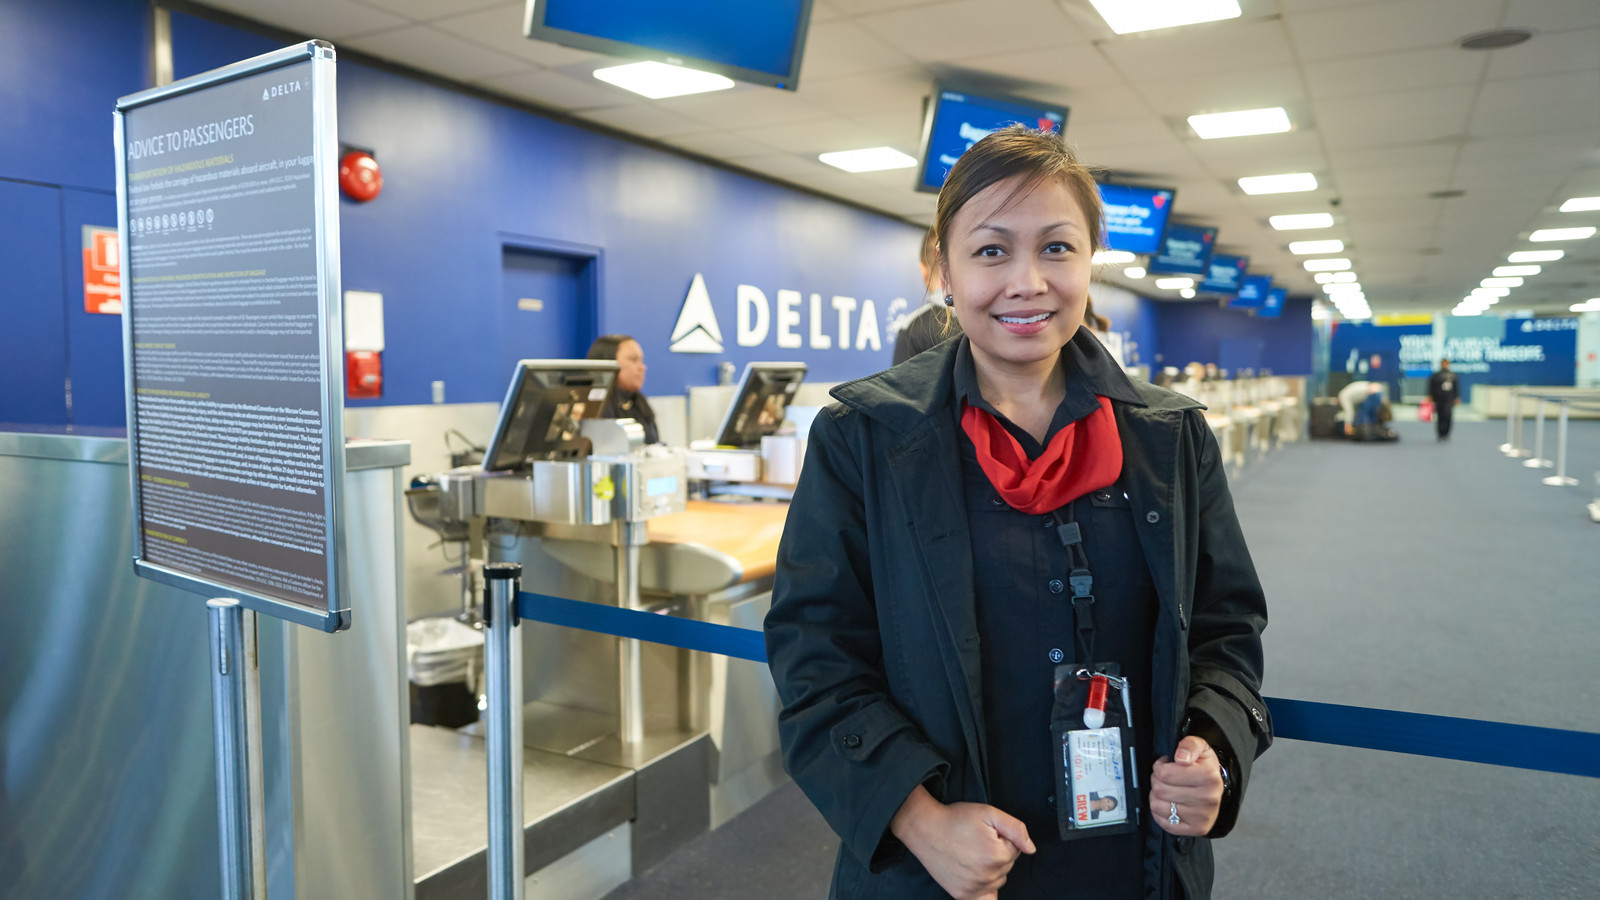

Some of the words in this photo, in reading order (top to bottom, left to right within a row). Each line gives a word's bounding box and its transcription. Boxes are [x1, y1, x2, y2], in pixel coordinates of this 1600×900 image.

[271, 80, 301, 97] DELTA
[128, 135, 165, 160] ADVICE
[166, 131, 181, 151] TO
[183, 114, 254, 149] PASSENGERS
[298, 154, 314, 168] lugga
[737, 284, 882, 351] DELTA
[1076, 794, 1088, 821] CREW
